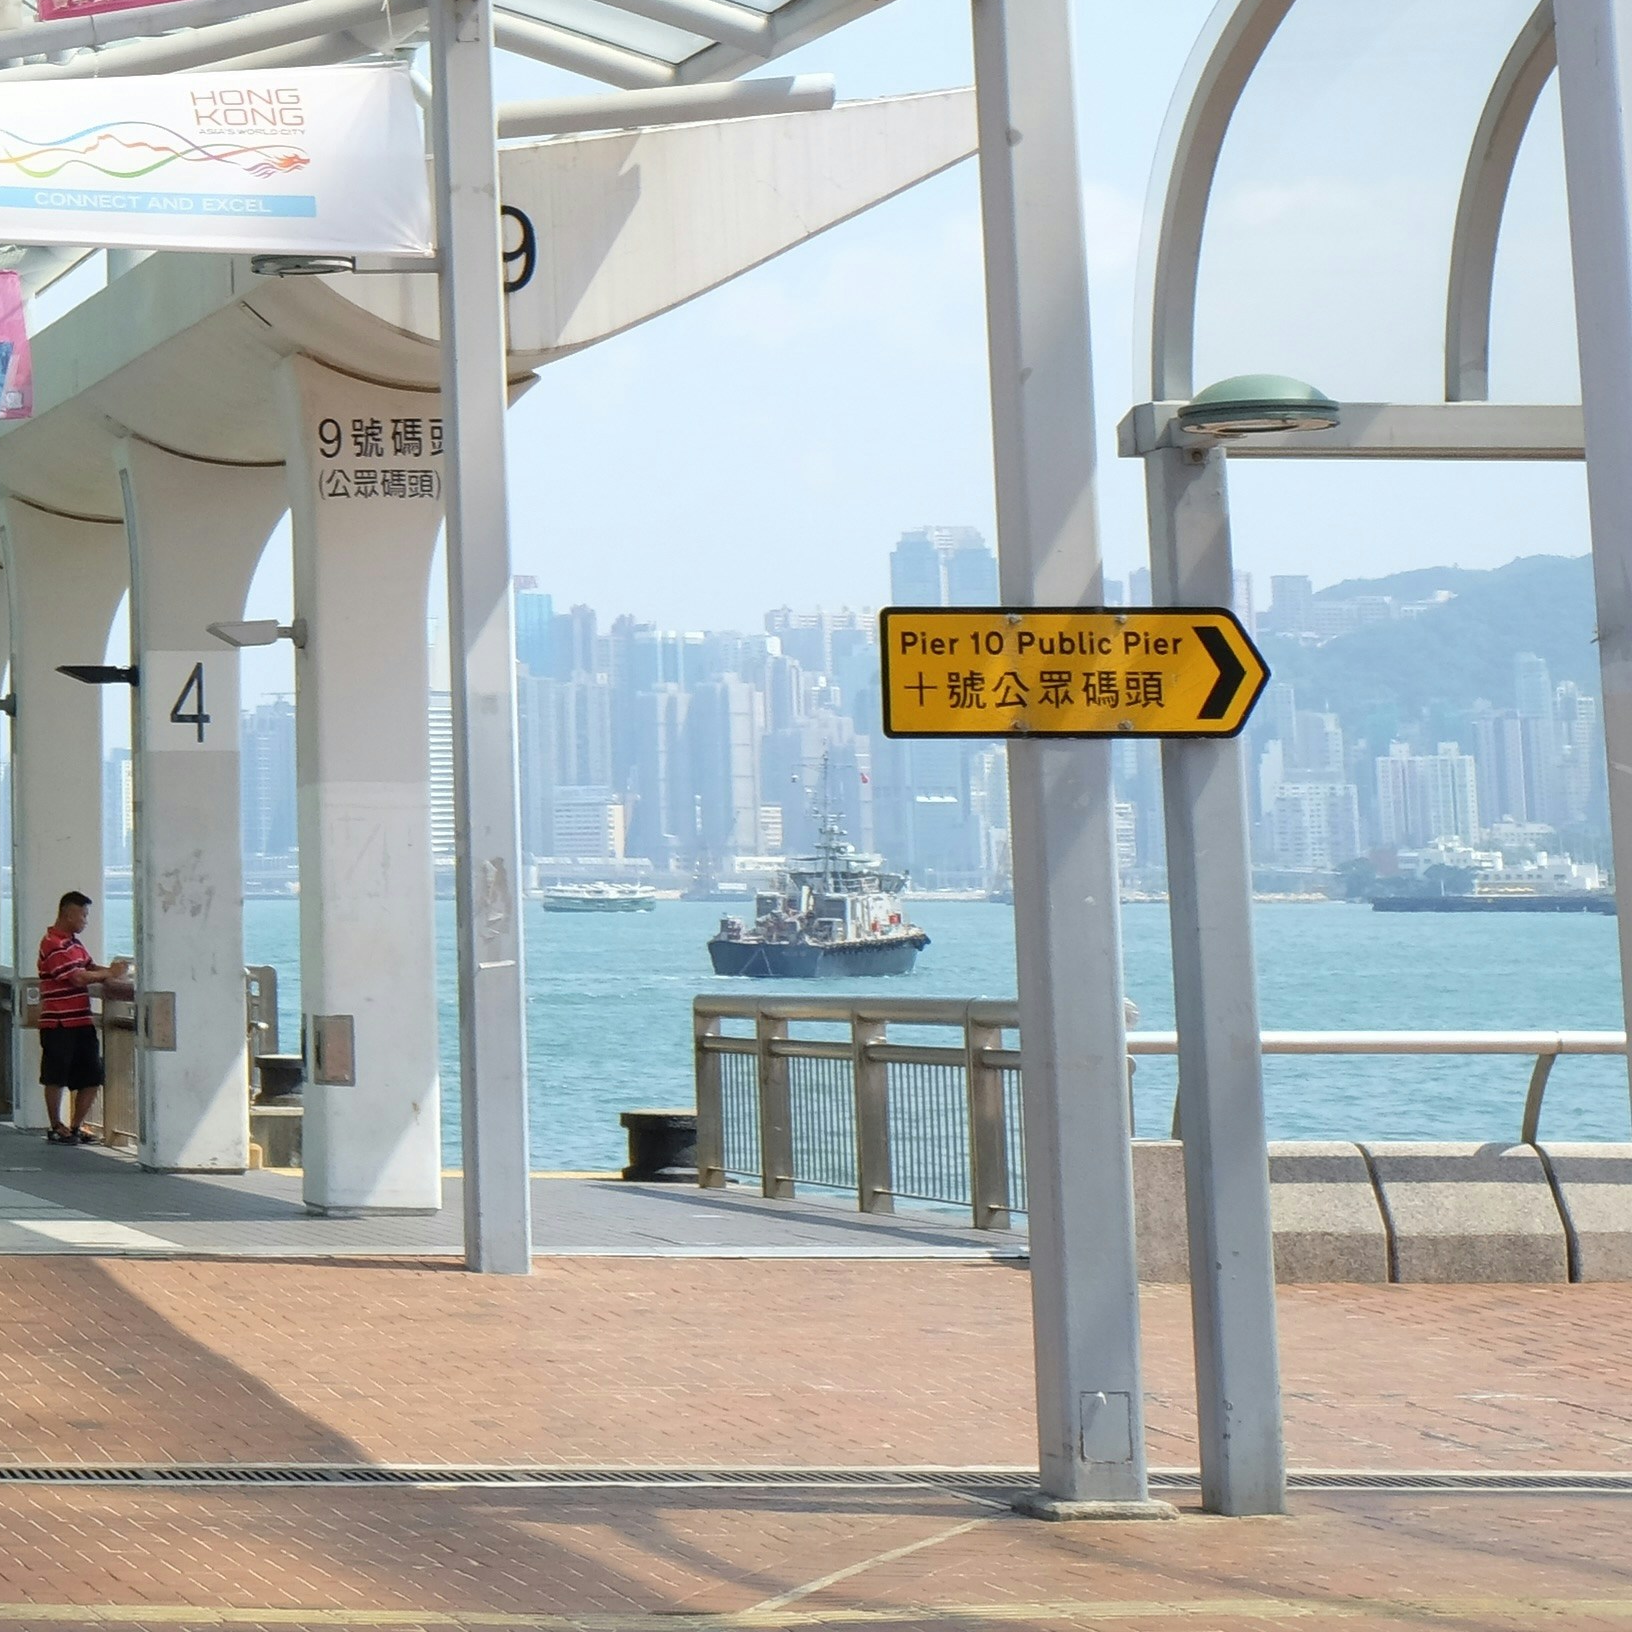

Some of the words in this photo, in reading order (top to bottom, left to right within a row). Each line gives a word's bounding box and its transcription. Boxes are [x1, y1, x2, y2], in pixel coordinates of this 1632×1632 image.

[190, 88, 300, 106] HONG
[195, 107, 304, 126] KONG
[35, 191, 140, 209] CONNECT
[147, 196, 193, 211] AND
[203, 198, 272, 213] EXCEL
[319, 468, 442, 501] (公眾碼頭)
[901, 631, 959, 655] Pier
[971, 631, 1004, 655] 10
[1017, 630, 1112, 655] Public
[1124, 631, 1182, 655] Pier
[170, 662, 211, 743] 4
[904, 670, 1165, 710] 十號公眾碼頭
